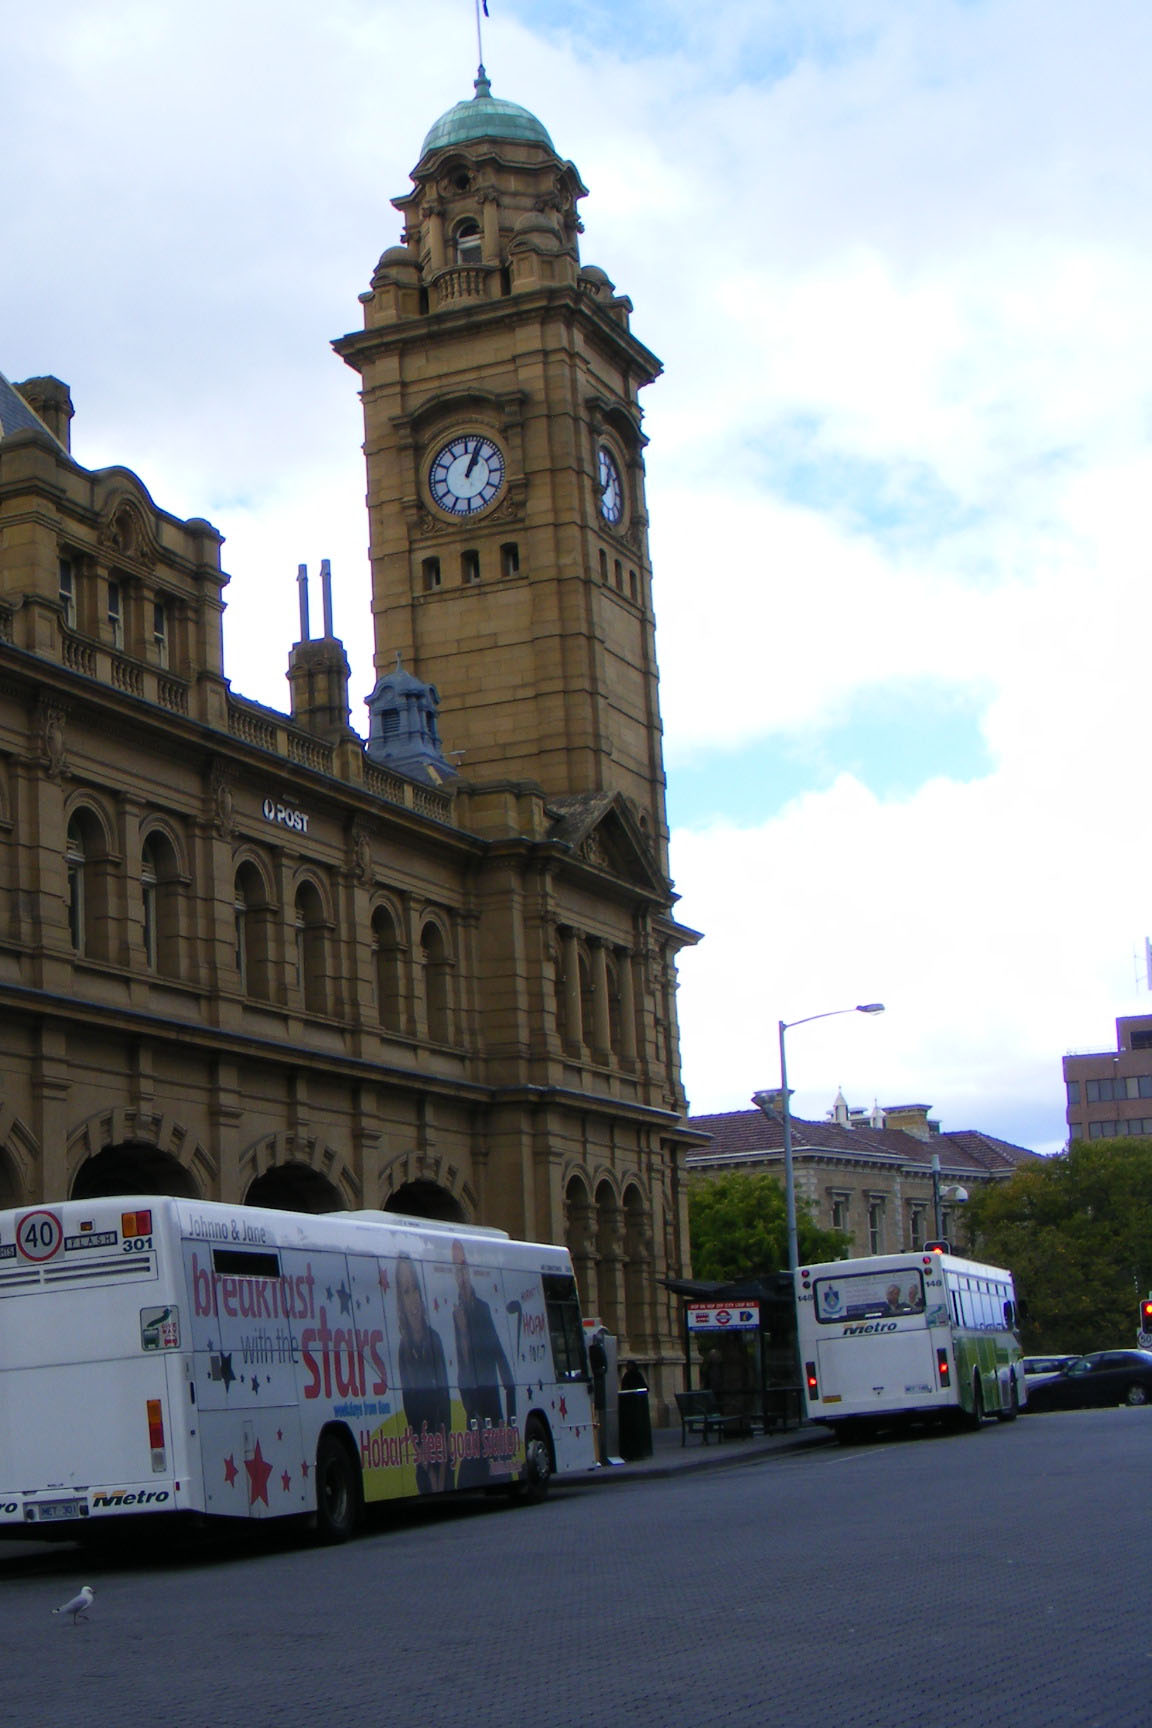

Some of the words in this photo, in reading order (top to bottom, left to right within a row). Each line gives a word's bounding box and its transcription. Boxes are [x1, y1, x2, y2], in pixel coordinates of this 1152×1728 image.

[275, 803, 309, 832] POST
[24, 1221, 53, 1248] 40
[68, 1234, 112, 1248] FLASH
[189, 1213, 228, 1240] Johnno
[231, 1219, 241, 1241] &
[242, 1219, 267, 1244] Jane
[122, 1237, 153, 1252] 301
[192, 1251, 315, 1319] breakfast
[842, 1322, 897, 1335] Metro
[241, 1328, 273, 1364] with
[276, 1327, 299, 1364] the
[301, 1305, 388, 1399] stars
[360, 1424, 419, 1469] Hobart's
[421, 1420, 448, 1465] feel
[450, 1429, 481, 1469] good
[92, 1489, 169, 1508] Metro
